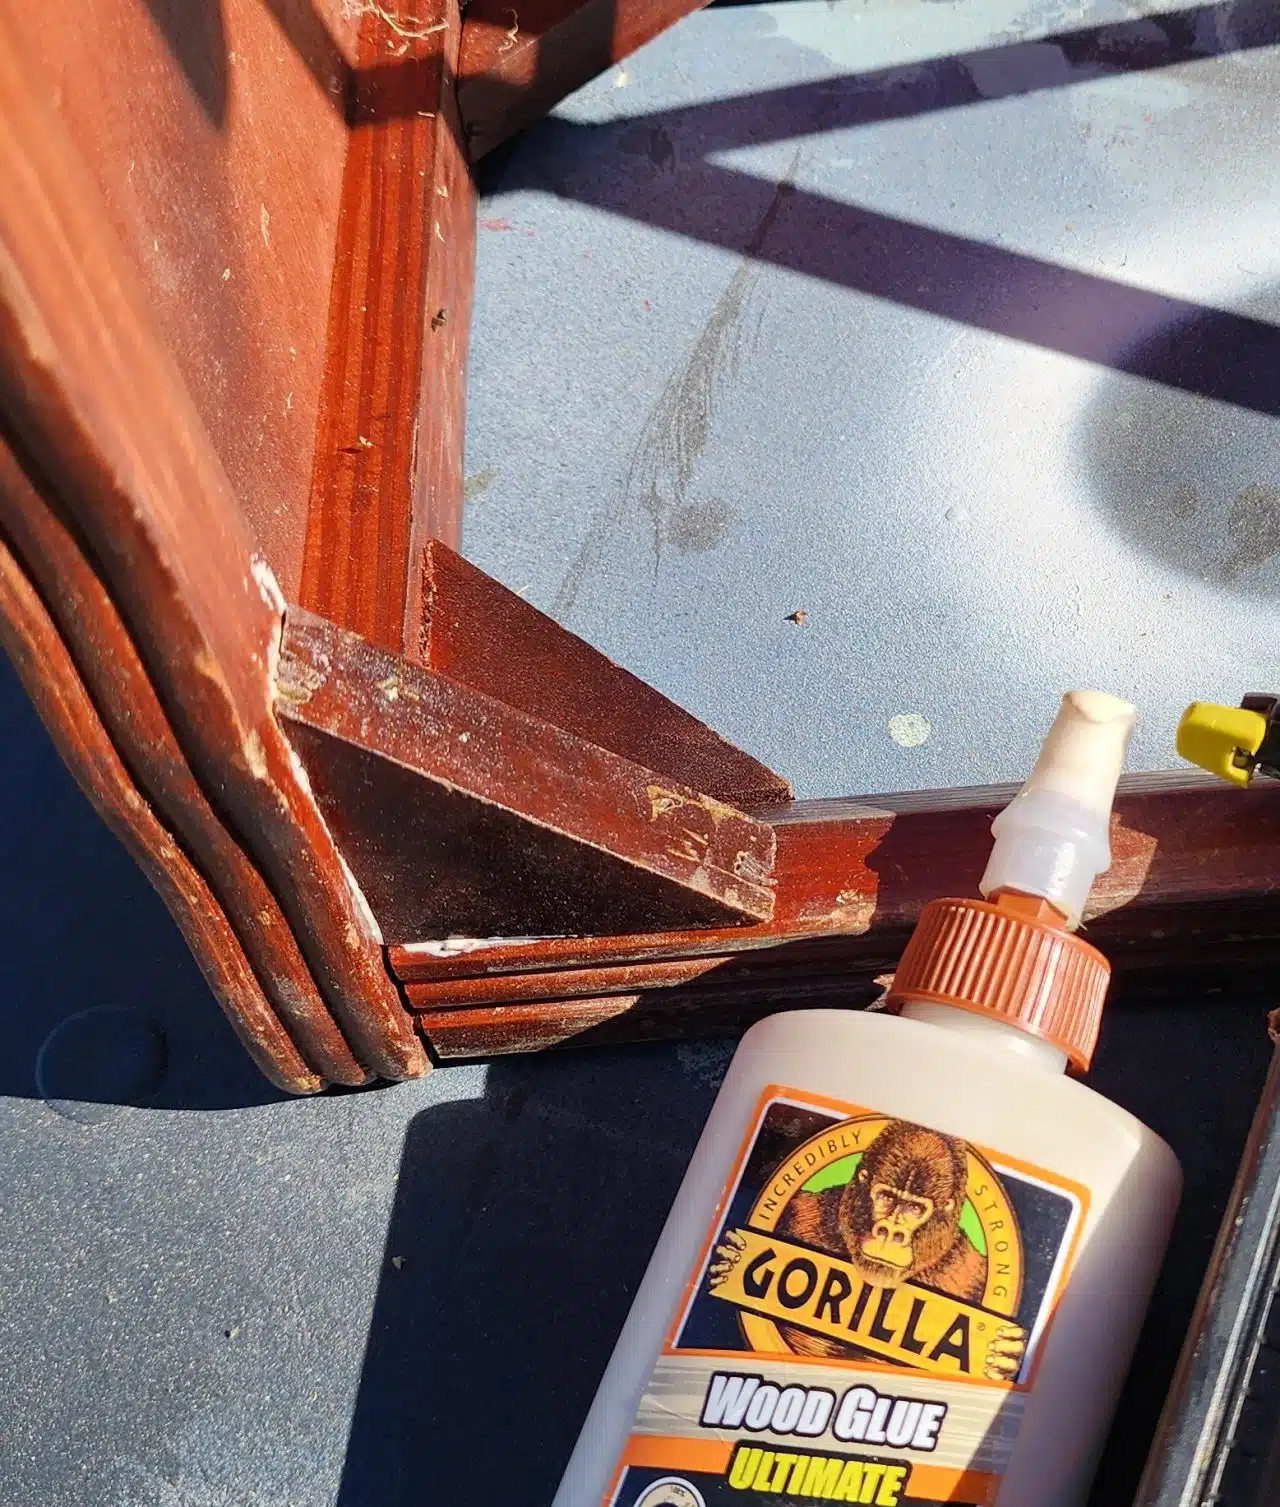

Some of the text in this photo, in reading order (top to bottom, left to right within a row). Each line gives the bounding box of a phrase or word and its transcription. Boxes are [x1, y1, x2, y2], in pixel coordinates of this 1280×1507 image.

[758, 1129, 862, 1221] INCREDIBLY
[974, 1184, 1010, 1298] STRONG
[742, 1247, 971, 1374] GORILLA
[702, 1374, 945, 1450] WOOD GLUE
[728, 1447, 907, 1507] ULTIMATE
